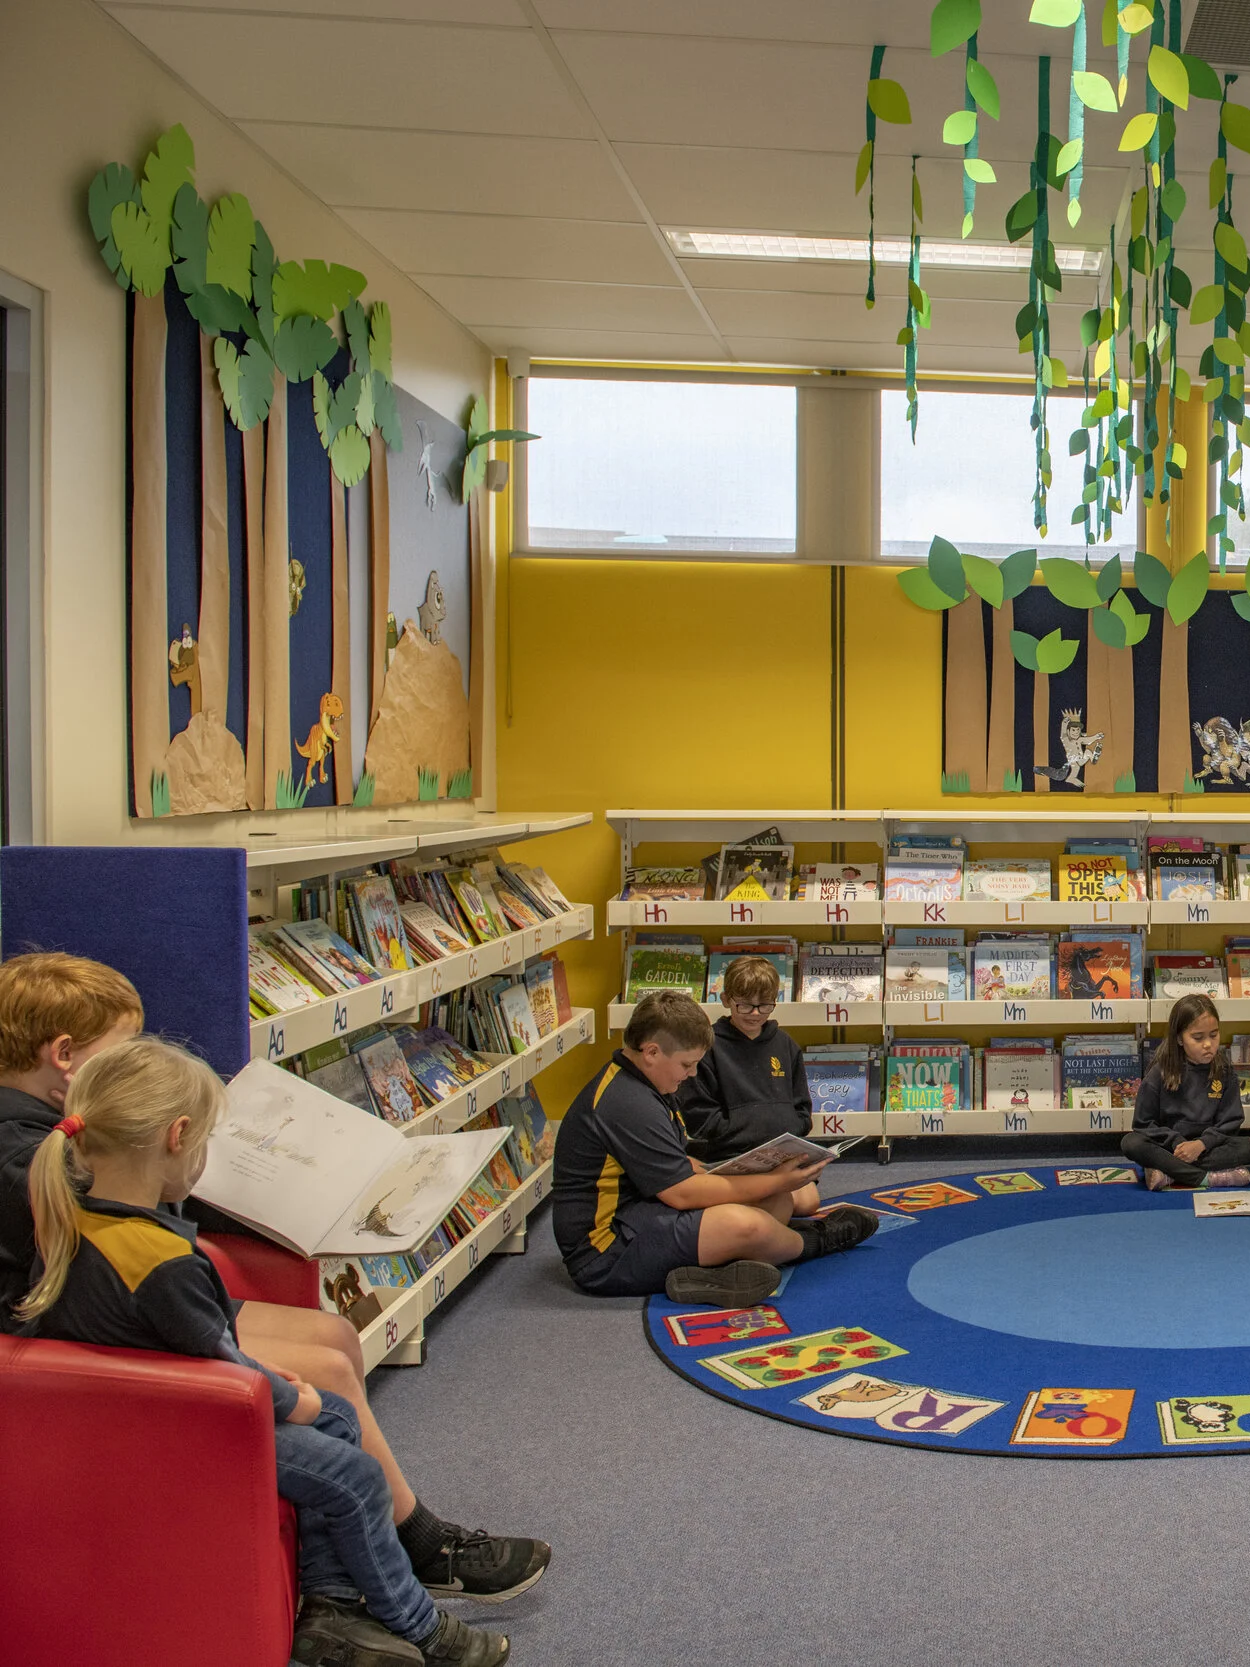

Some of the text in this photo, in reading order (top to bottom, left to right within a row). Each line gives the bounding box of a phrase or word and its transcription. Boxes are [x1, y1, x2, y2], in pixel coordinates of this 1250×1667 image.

[1066, 856, 1114, 871] DO NOT
[1158, 856, 1218, 865] On the Moon
[819, 877, 841, 887] WAS
[1067, 868, 1117, 882] OPEN
[820, 887, 839, 896] NOT
[1067, 881, 1105, 896] THIS
[644, 903, 668, 923] Hh
[731, 903, 753, 922] Hh
[826, 903, 849, 922] Hh
[924, 903, 946, 922] Kk
[1005, 903, 1025, 922] Ll
[1094, 903, 1112, 922] Ll
[1188, 903, 1209, 922] Mm
[989, 950, 1040, 960] MADDIE'S
[810, 966, 873, 976] DETECTIVE
[1005, 960, 1038, 972] FIRST
[431, 966, 442, 995] Cc
[645, 969, 691, 985] GARDEN
[1010, 971, 1033, 983] DAY
[381, 985, 394, 1016] Aa
[889, 990, 945, 1000] Invisible
[333, 1001, 347, 1034] Aa
[826, 1003, 849, 1022] Hh
[923, 1003, 944, 1022] Ll
[1004, 1002, 1026, 1021] Mm
[1091, 1001, 1113, 1020] Mm
[267, 1024, 285, 1060] Aa
[1064, 1059, 1085, 1069] NOT
[1086, 1059, 1106, 1068] LAST
[896, 1062, 953, 1089] NOW
[467, 1089, 477, 1119] Dd
[905, 1089, 941, 1107] THAT'S
[823, 1115, 845, 1134] Kk
[921, 1114, 944, 1132] Mm
[1005, 1112, 1028, 1131] Mm
[1090, 1110, 1112, 1129] Mm
[1100, 1168, 1132, 1182] Z
[468, 1238, 479, 1270] Dd
[434, 1271, 445, 1304] Dd
[386, 1317, 398, 1350] Bb
[891, 1392, 990, 1431] R
